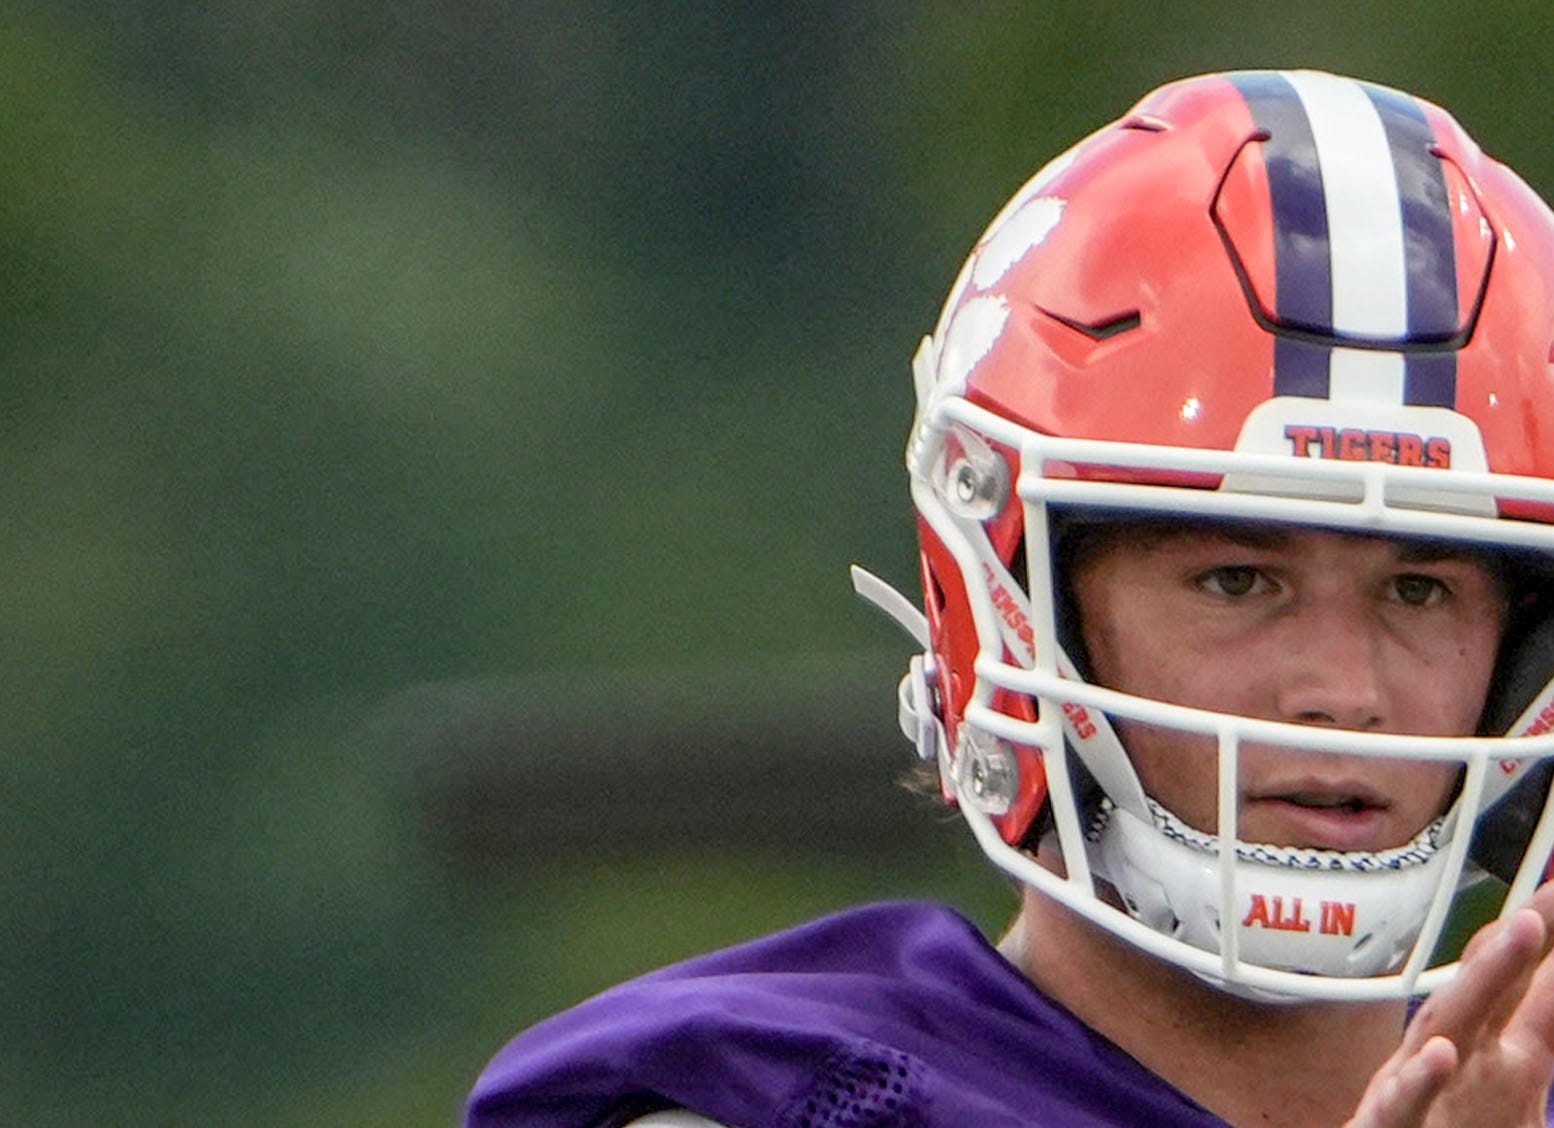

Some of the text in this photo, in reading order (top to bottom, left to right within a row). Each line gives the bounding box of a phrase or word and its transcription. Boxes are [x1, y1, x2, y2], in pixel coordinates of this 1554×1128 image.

[1284, 424, 1451, 470] TIGERS
[1242, 894, 1356, 937] ALL IN
